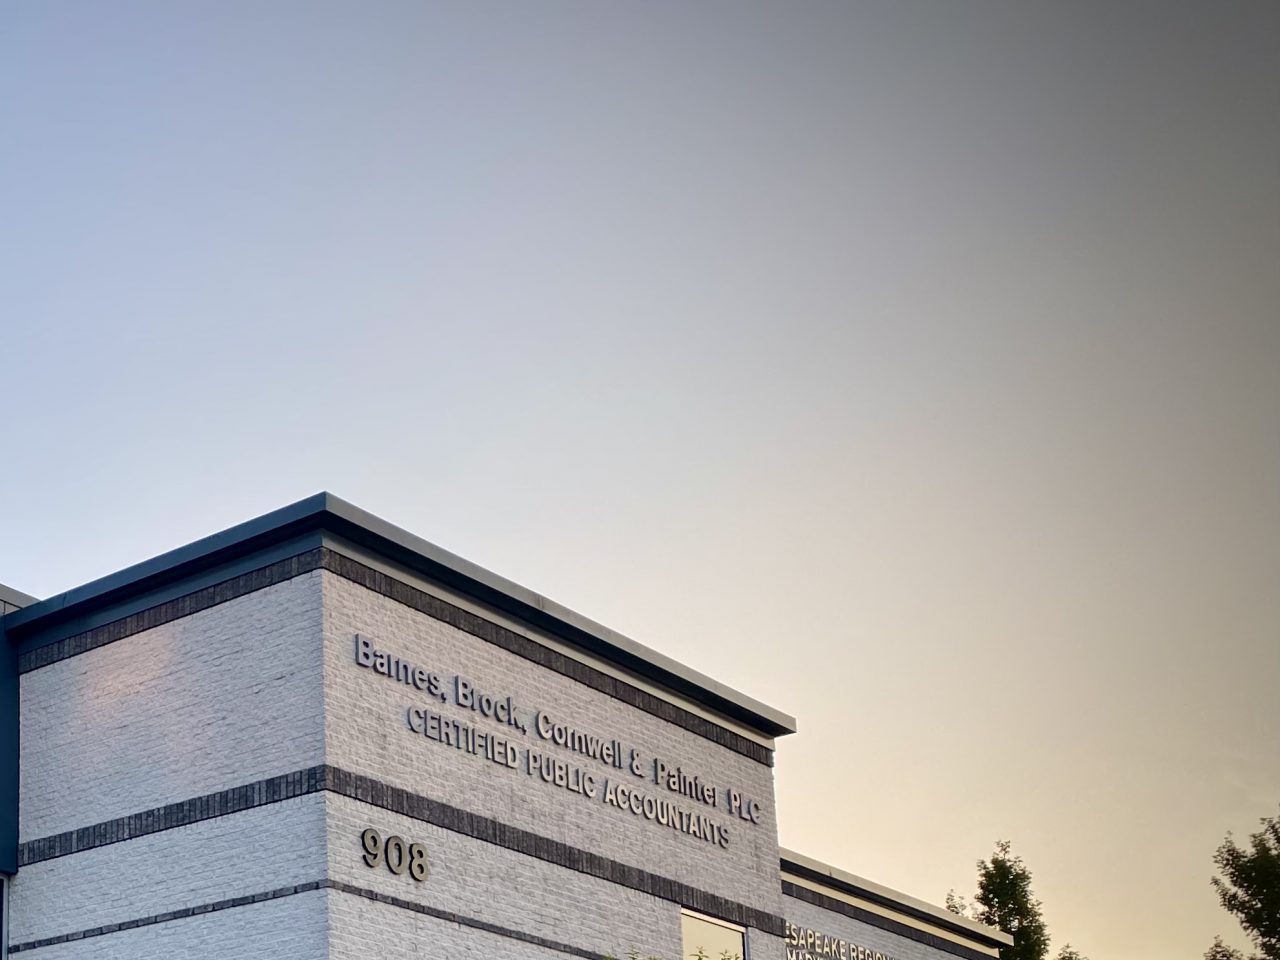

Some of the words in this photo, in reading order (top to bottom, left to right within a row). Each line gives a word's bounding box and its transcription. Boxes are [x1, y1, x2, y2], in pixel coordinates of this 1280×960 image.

[407, 705, 519, 768] CERTIFIED
[526, 749, 597, 799] PUBLIC
[603, 780, 730, 849] ACCOUNTANTS
[454, 675, 527, 735] Brock,
[535, 711, 623, 769] Cornwell
[630, 749, 645, 778] &
[653, 757, 718, 807] Painter
[728, 788, 761, 824] PLC
[361, 828, 430, 882] 908
